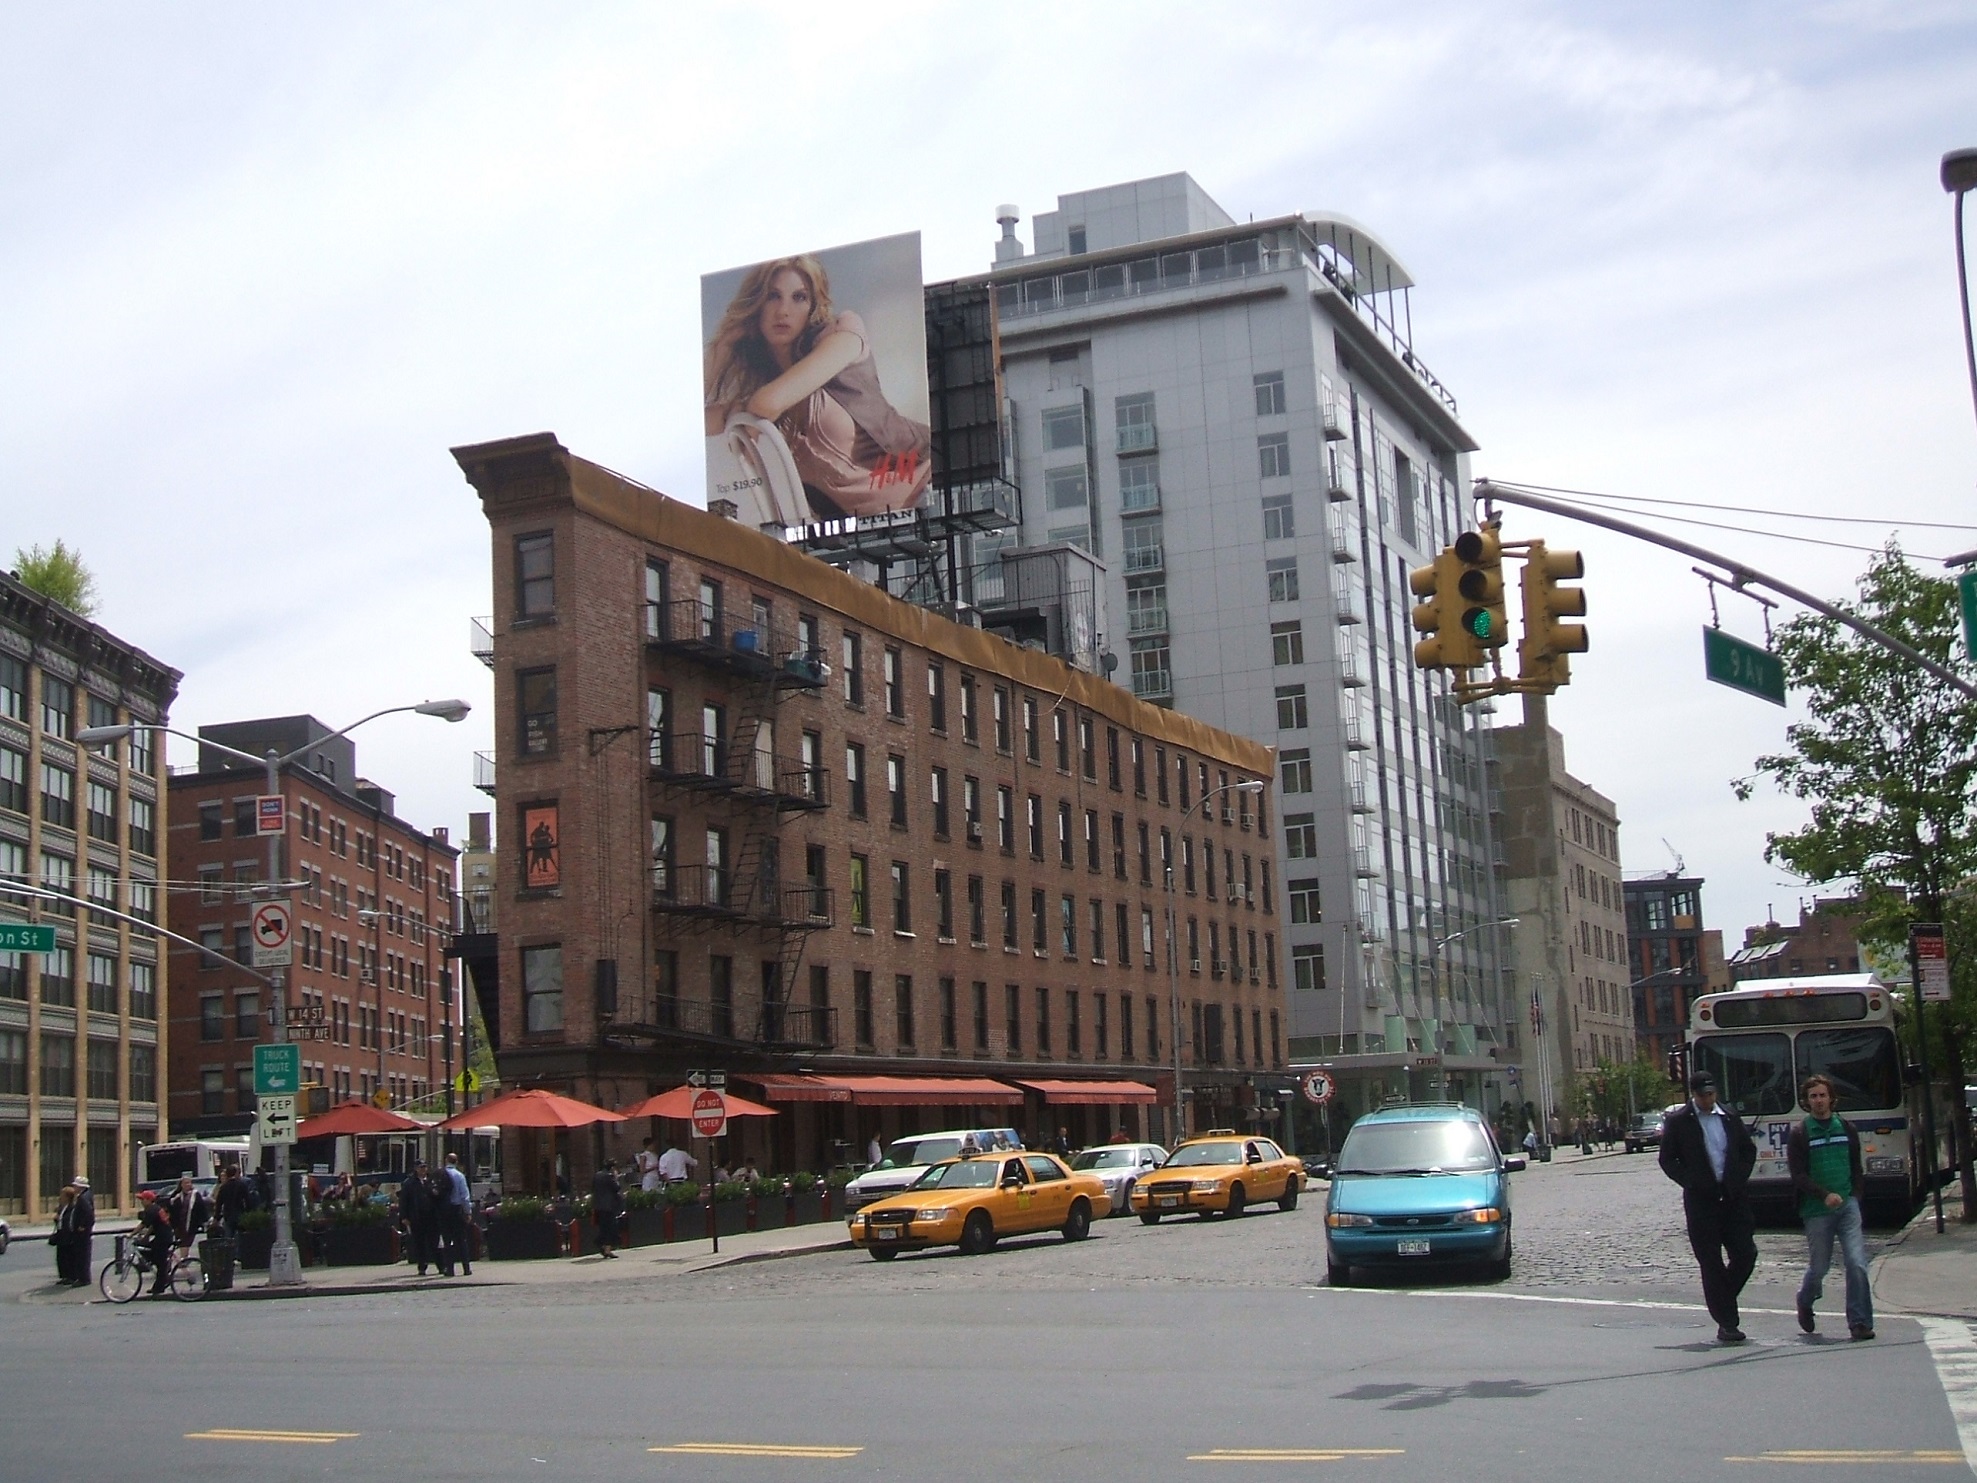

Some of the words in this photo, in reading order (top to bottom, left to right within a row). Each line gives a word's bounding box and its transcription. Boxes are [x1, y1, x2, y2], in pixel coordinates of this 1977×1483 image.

[870, 448, 918, 489] H&M
[716, 484, 730, 494] Top
[733, 477, 762, 492] $19.90
[859, 510, 913, 525] TITAN
[1730, 648, 1740, 677] 9
[20, 931, 38, 946] St
[287, 1009, 296, 1020] W
[299, 1009, 309, 1019] 14
[312, 1007, 323, 1019] ST
[314, 1027, 329, 1039] AVE
[263, 1050, 290, 1061] TRUCK
[262, 1062, 290, 1073] ROUTE
[261, 1100, 292, 1111] KEEP
[696, 1100, 706, 1108] DO
[707, 1098, 721, 1107] NOT
[698, 1119, 720, 1128] ENTER
[1771, 1123, 1788, 1131] NY
[1772, 1133, 1780, 1149] 1
